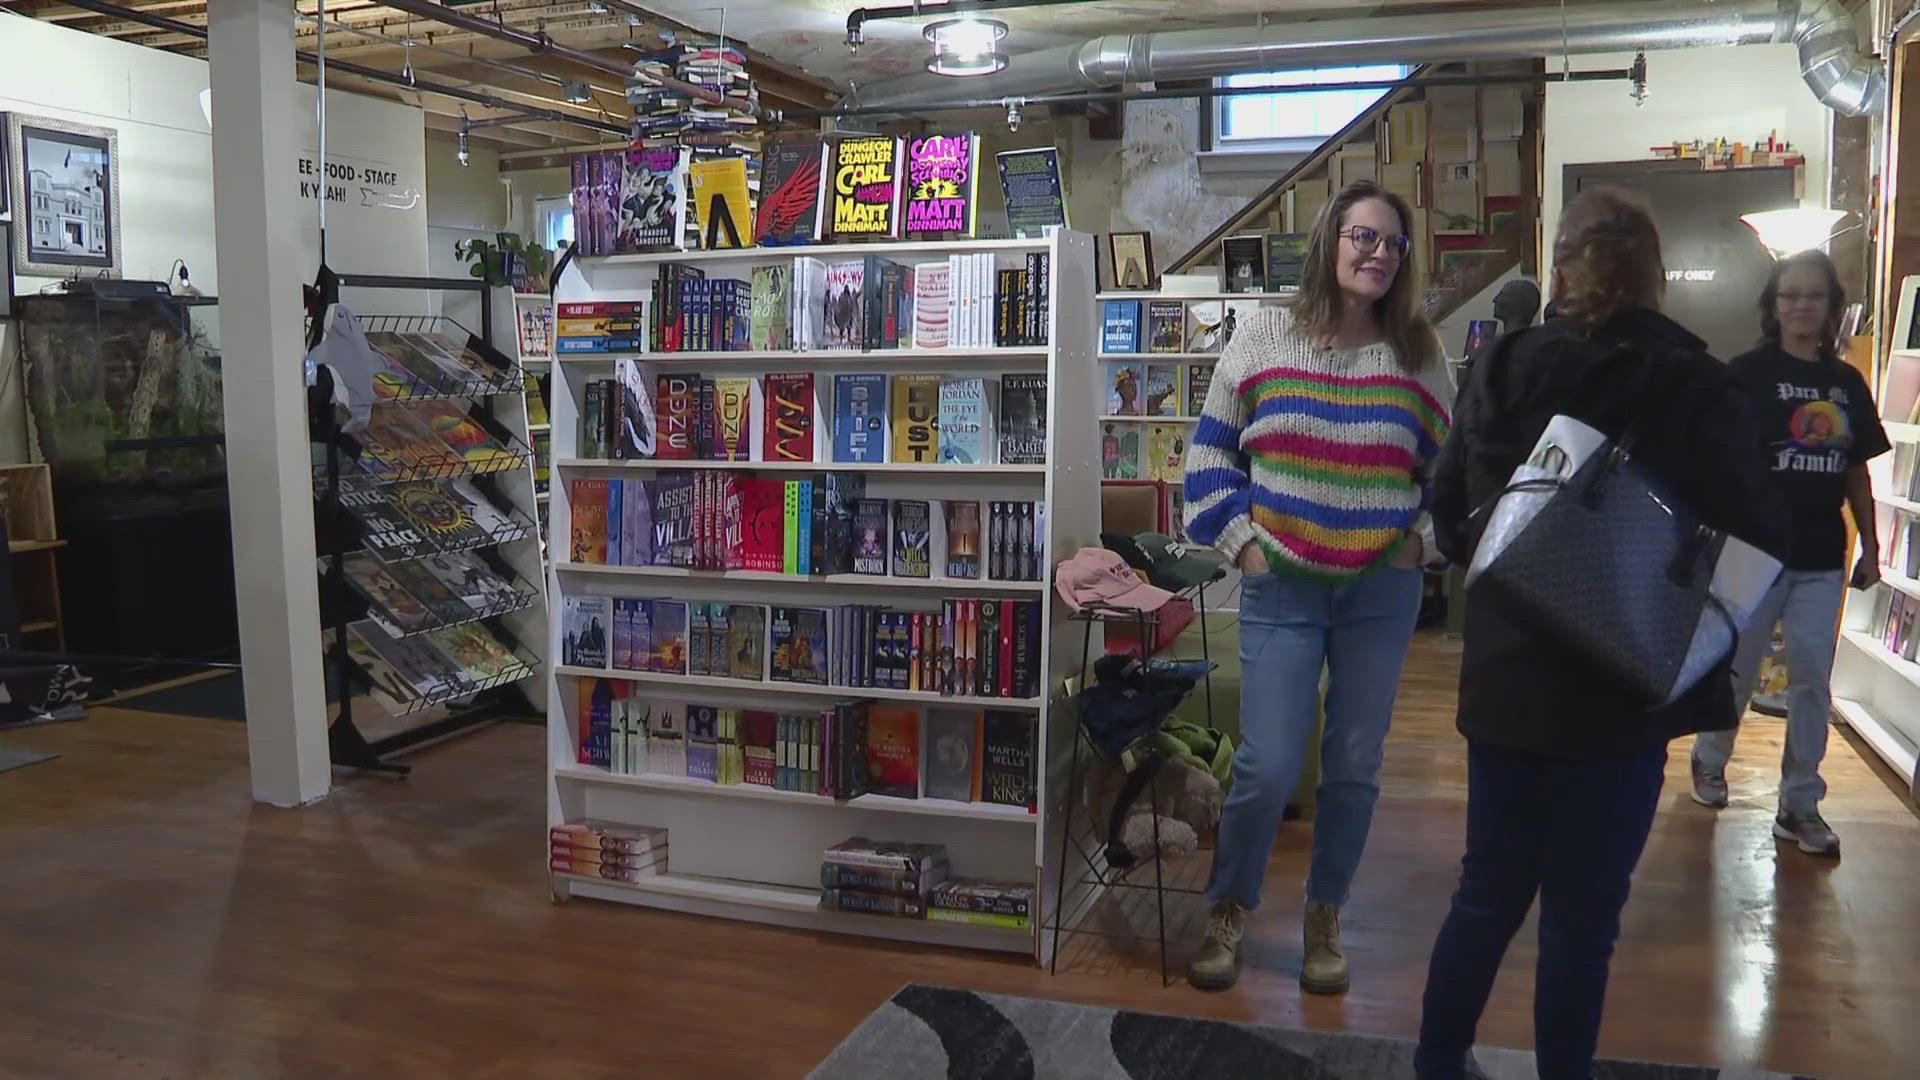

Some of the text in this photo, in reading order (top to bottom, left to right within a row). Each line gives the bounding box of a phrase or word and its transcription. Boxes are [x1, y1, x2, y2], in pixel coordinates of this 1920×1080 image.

[840, 140, 892, 154] DUNGEON
[839, 152, 891, 164] CRAWLER
[365, 169, 397, 186] STAGE
[836, 163, 892, 196] CARL
[835, 195, 889, 222] MATT
[908, 200, 966, 220] MATT
[834, 221, 887, 232] DINNIMAN
[907, 219, 963, 231] DINNIMAN
[639, 229, 668, 237] BRANDON
[635, 237, 671, 245] SANDERSON
[1684, 270, 1715, 281] ONLY
[943, 380, 979, 390] ROBERT
[1776, 382, 1820, 400] Para
[942, 390, 980, 400] JORDAN
[669, 379, 687, 449] DUNE
[944, 405, 978, 413] THE EYE
[850, 387, 868, 461] SHIFT
[941, 424, 980, 434] WORLD
[340, 490, 387, 508] STICE
[366, 518, 396, 533] NO
[368, 529, 422, 549] PEACE
[988, 745, 1030, 758] MARTHA
[993, 755, 1025, 767] WELLS
[993, 785, 1025, 802] KING
